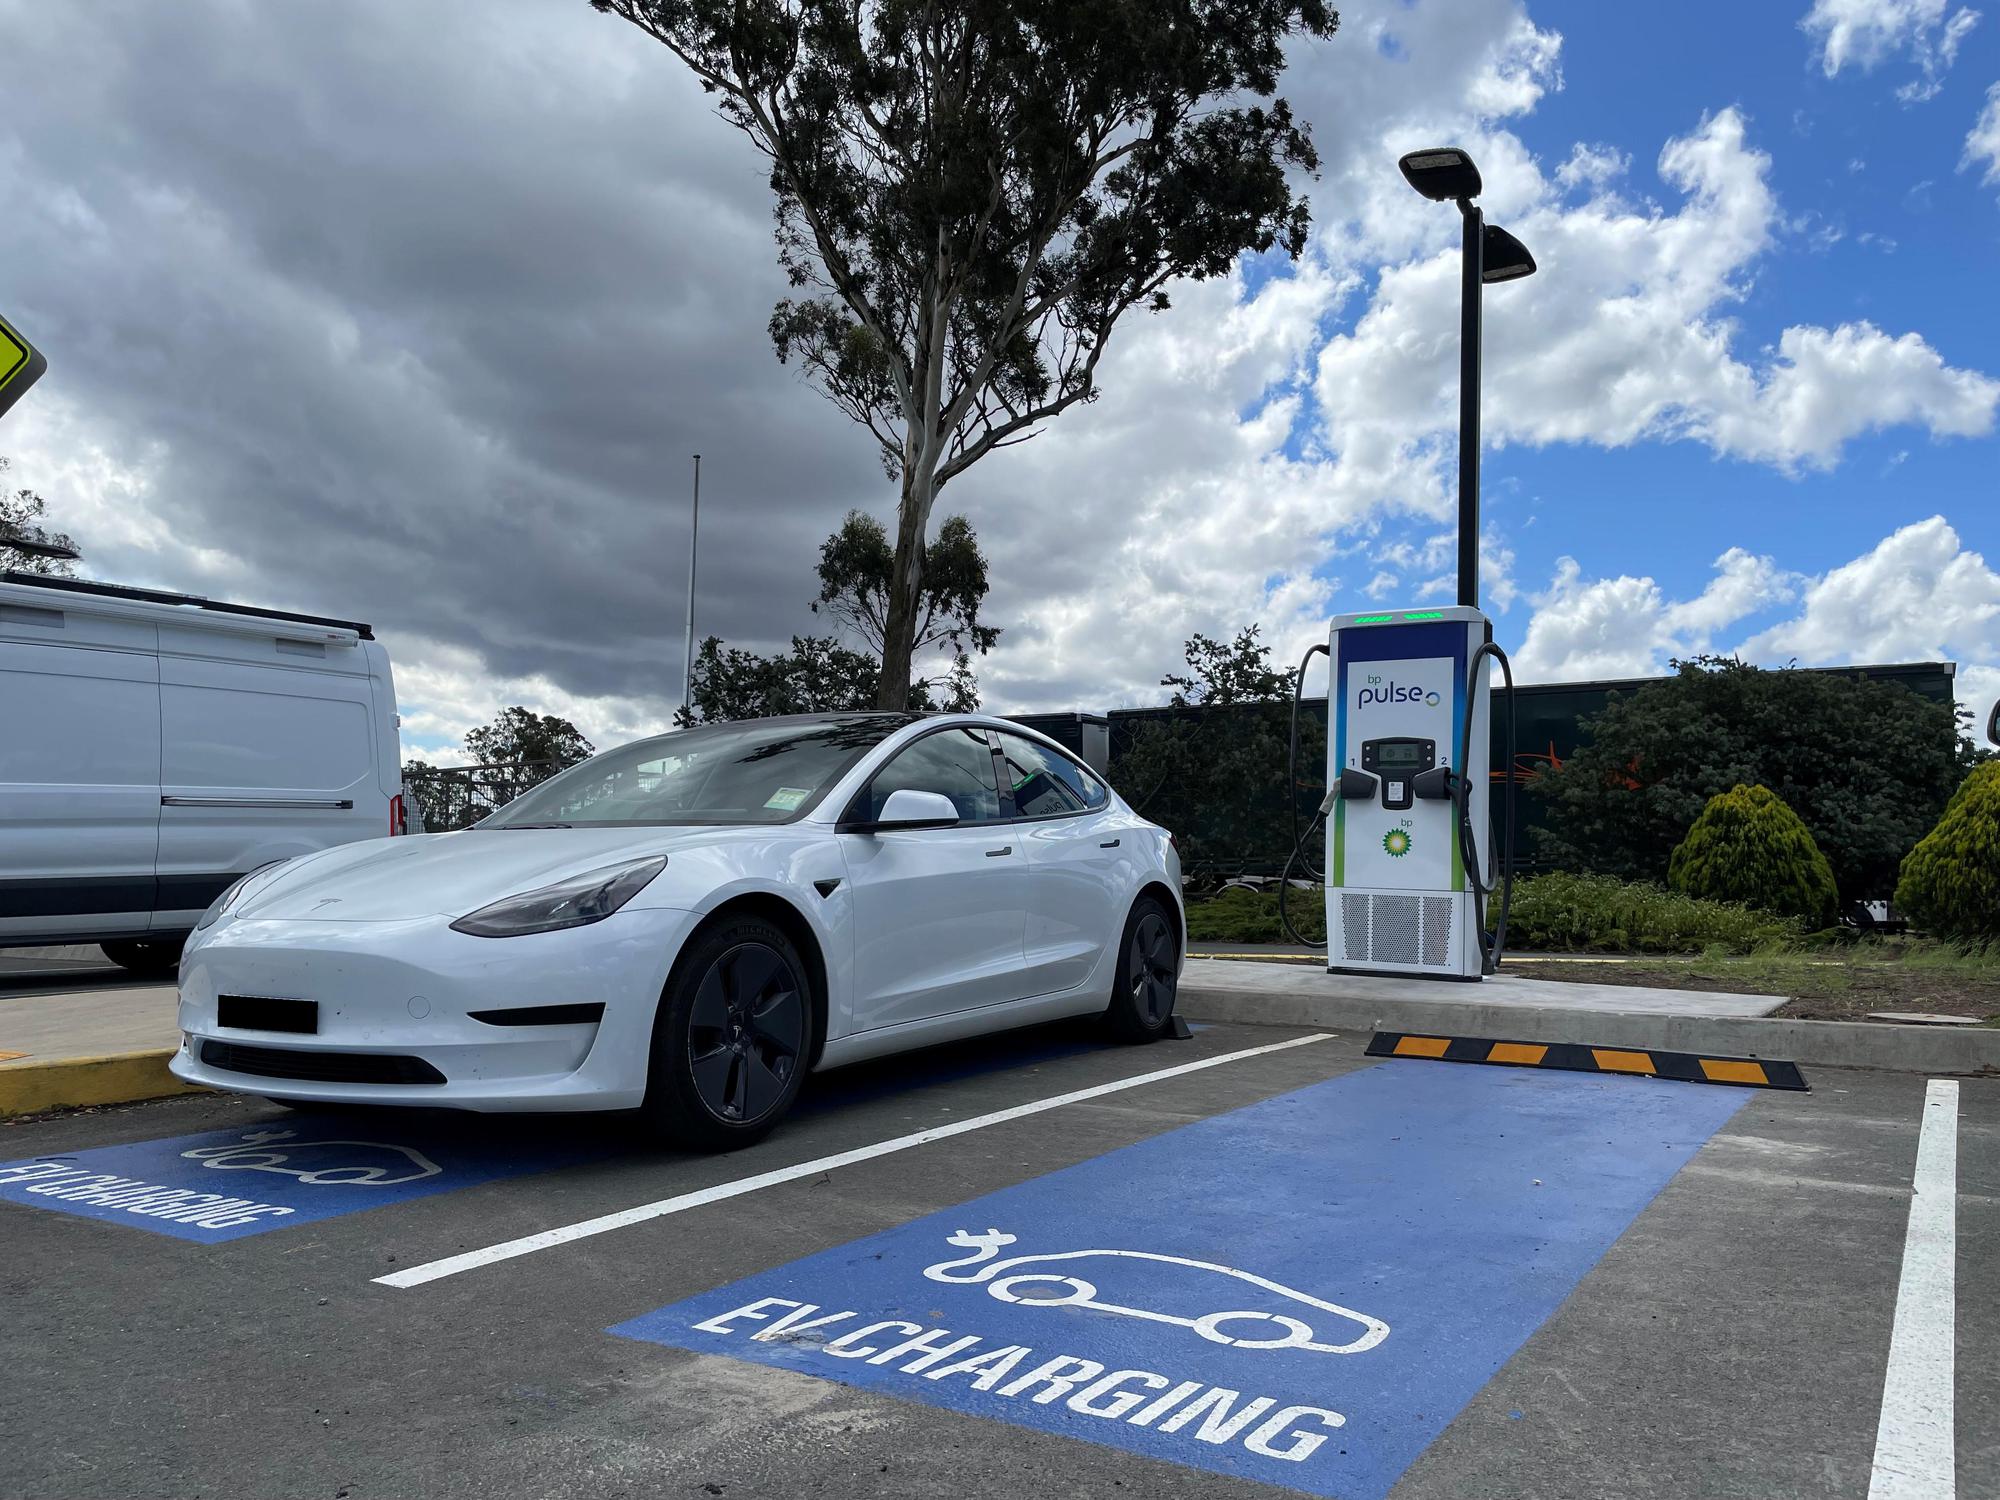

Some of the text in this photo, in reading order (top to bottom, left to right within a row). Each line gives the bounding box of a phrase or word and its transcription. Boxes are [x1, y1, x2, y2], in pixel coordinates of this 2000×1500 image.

[1367, 674, 1381, 685] bp
[1358, 681, 1423, 710] pulse
[1351, 758, 1355, 766] 1
[1441, 757, 1447, 765] 2
[1401, 818, 1413, 827] bp
[25, 1174, 295, 1229] CHARGING
[692, 1297, 1347, 1462] EV CHARGING
